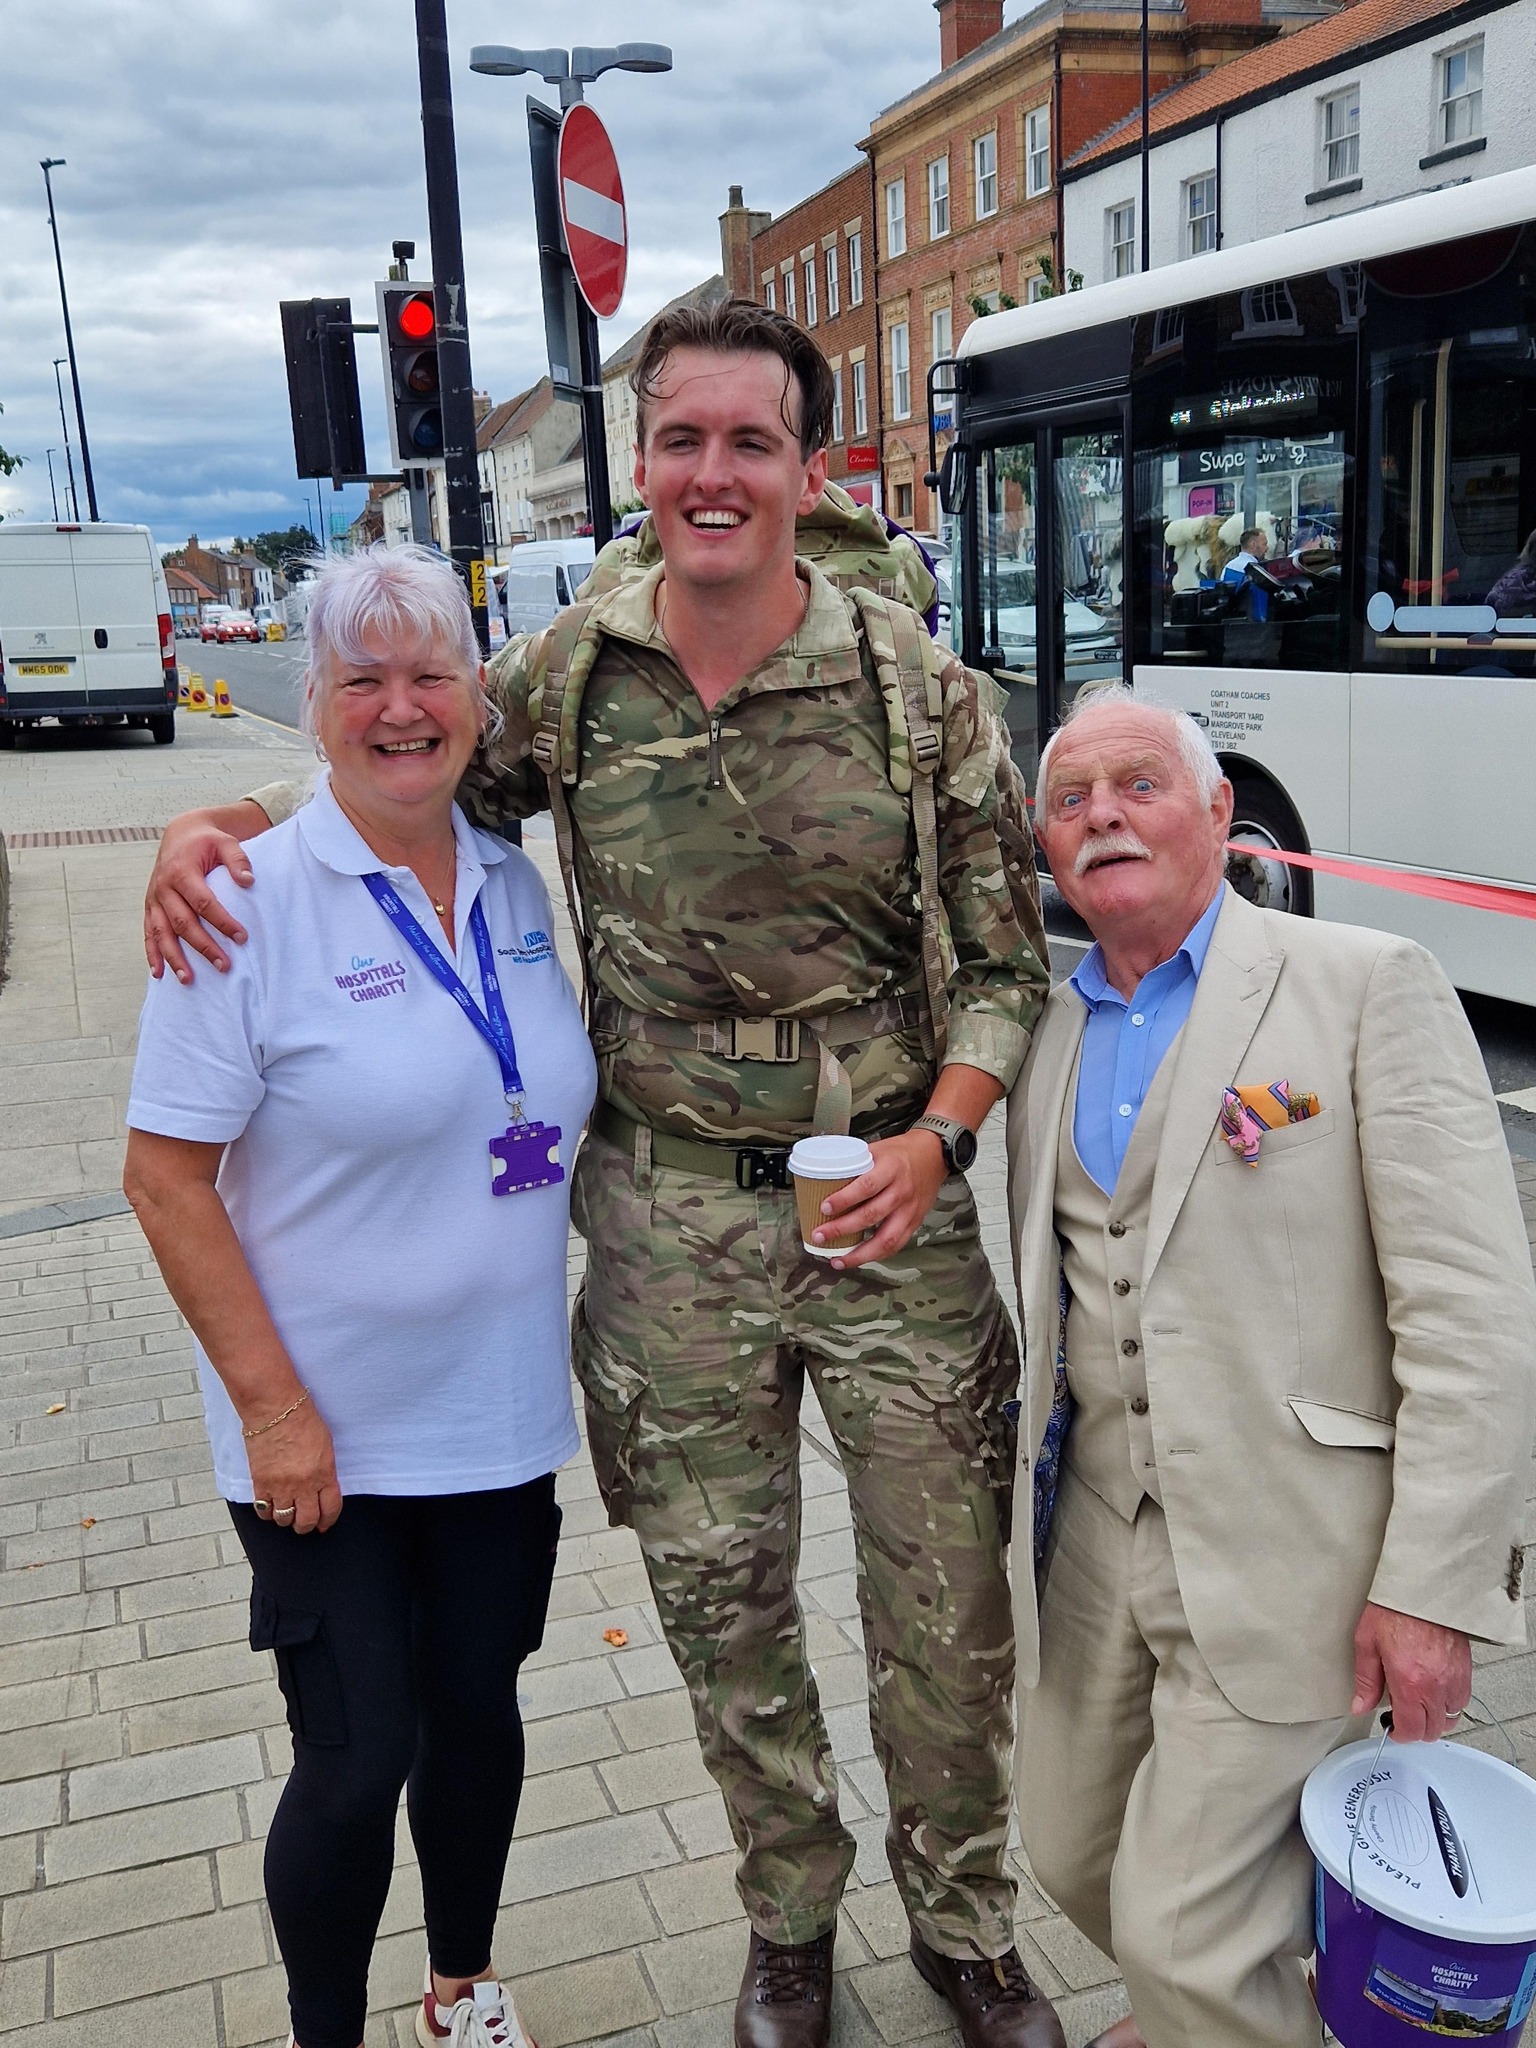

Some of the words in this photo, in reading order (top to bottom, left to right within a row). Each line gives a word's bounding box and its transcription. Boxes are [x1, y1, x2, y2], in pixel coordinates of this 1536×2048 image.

[476, 563, 485, 581] 2
[477, 586, 487, 604] 2
[1210, 690, 1240, 699] COATHAM
[1240, 691, 1271, 701] COACHES
[1210, 700, 1225, 708] UNIT
[1225, 701, 1229, 709] 2
[1211, 710, 1247, 720] TRANSPORT
[1247, 712, 1265, 721] YARD
[1211, 720, 1245, 730] MARGROVE
[1245, 723, 1263, 731] PARK
[1210, 730, 1247, 740] CLEVELAND
[1211, 740, 1225, 749] TS12
[351, 955, 376, 971] Our
[334, 960, 406, 989] HOSPITALS
[349, 978, 406, 1003] CHARITY
[1444, 1837, 1464, 1879] THANK
[1367, 1852, 1421, 1890] PLEASE
[1431, 1964, 1479, 1982] HOSPITALS
[1449, 1962, 1467, 1971] Our
[1433, 1974, 1473, 1990] CHARITY
